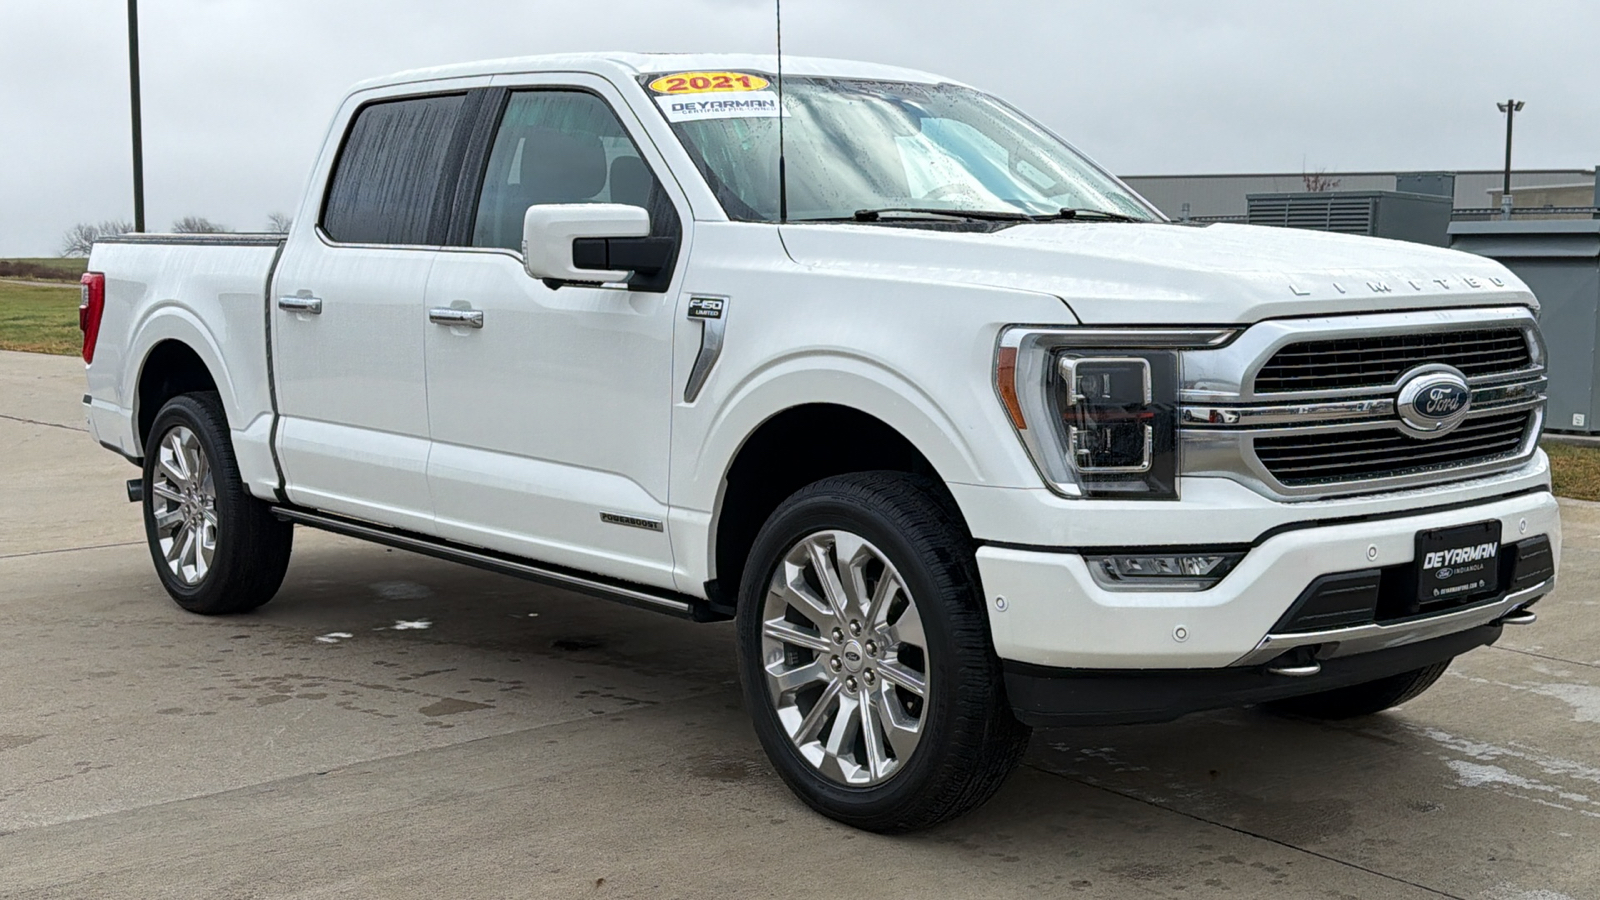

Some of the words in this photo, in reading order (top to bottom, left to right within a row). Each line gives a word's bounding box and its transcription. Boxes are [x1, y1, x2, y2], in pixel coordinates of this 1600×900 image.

[666, 75, 752, 92] 2021
[671, 99, 775, 112] DEYARMAN
[1289, 277, 1505, 296] LIMITED
[690, 299, 723, 310] F-150
[1426, 387, 1460, 413] Ford
[602, 512, 659, 529] POWERBOOST
[1423, 541, 1498, 570] DEYARMAN
[1453, 563, 1484, 575] INDIANOLA
